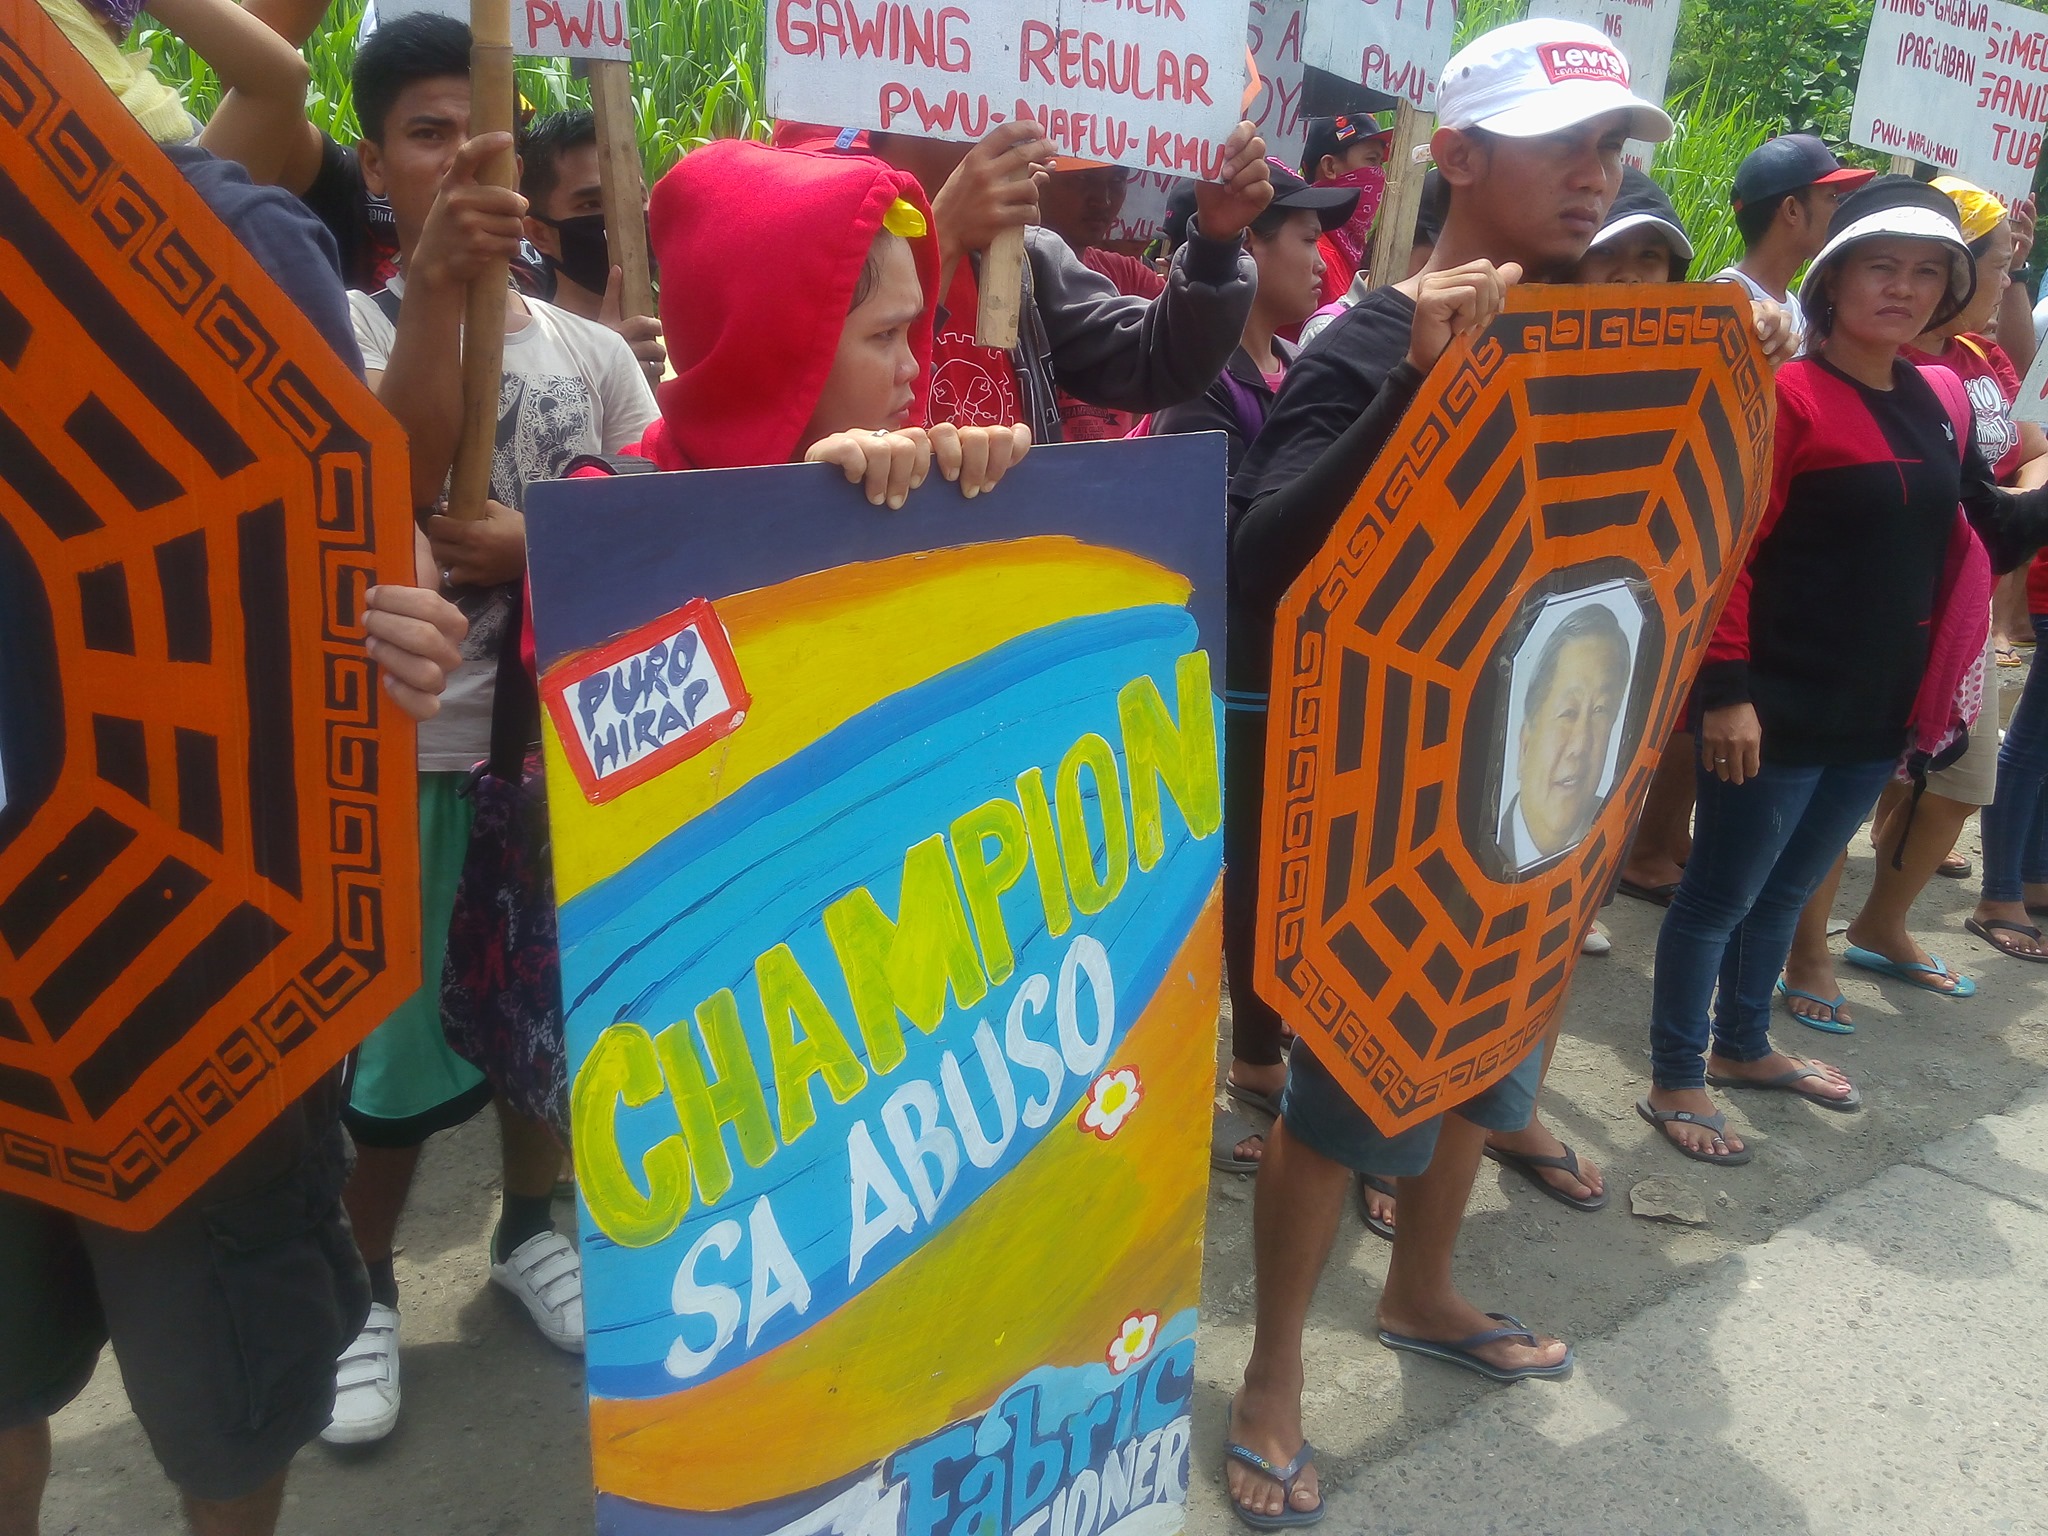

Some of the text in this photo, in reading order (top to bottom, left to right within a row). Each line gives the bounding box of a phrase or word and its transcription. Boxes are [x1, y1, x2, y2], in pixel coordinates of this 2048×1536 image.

[776, 0, 1214, 107] GAWING REGULAR
[1896, 31, 1976, 87] IPAG-LABAN
[578, 629, 698, 741] PURO
[593, 678, 709, 779] HIRAP
[570, 648, 1223, 1248] CHAMPION
[663, 934, 1117, 1380] SA ABUSO
